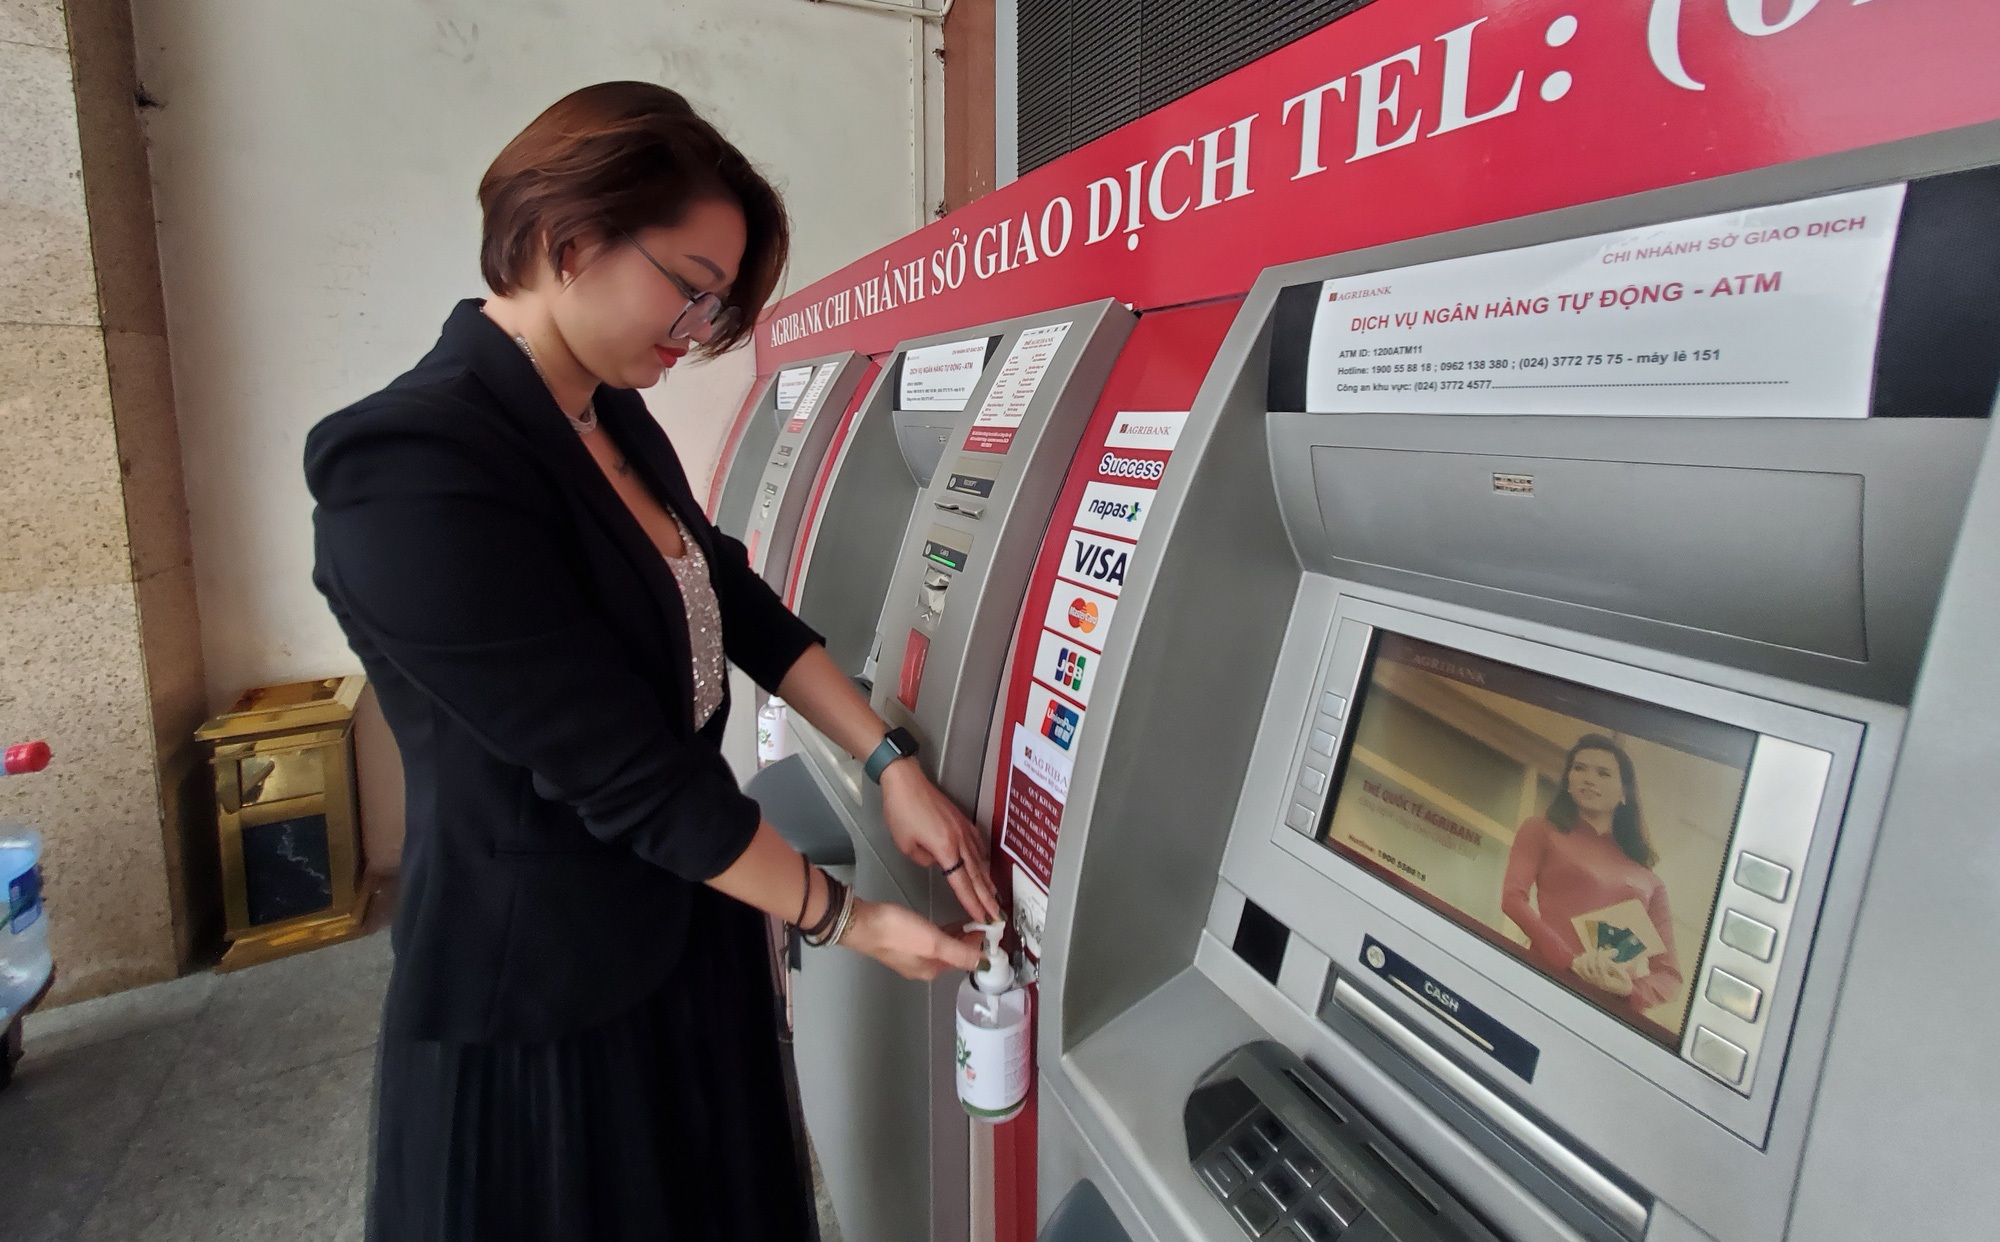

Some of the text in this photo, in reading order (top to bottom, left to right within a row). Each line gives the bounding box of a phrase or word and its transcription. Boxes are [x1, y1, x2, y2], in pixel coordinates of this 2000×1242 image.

[770, 301, 823, 347] AGRIBANK
[825, 289, 851, 329] CHI
[853, 257, 925, 320] NHÁNH
[932, 228, 968, 296] SỞ
[974, 196, 1073, 279] GIAO
[1084, 113, 1259, 251] DỊCH
[1282, 15, 1578, 182] TEL:
[1602, 216, 1866, 265] CHI NHÁNH SỞ GIAO DỊCH
[1337, 286, 1392, 301] AGRIBANK
[1351, 315, 1389, 334] DỊCH
[1395, 311, 1417, 329] VỤ
[1423, 303, 1479, 324] NGÂN
[1485, 296, 1549, 318] HÀNG
[1558, 291, 1593, 314] TỰ
[1600, 282, 1683, 310] ĐỘNG
[1710, 271, 1782, 298] ATM
[1338, 365, 1369, 375] Hotline:
[1371, 365, 1391, 374] 1900
[1394, 364, 1405, 373] 55
[1406, 363, 1418, 372] 88
[1421, 363, 1432, 372] 18
[1440, 361, 1464, 371] 0962
[1467, 361, 1486, 370] 138
[1489, 360, 1508, 369] 380
[1519, 357, 1548, 370] (024)
[1552, 355, 1582, 367] 3772
[1586, 354, 1602, 365] 75
[1607, 353, 1623, 365] 75
[1636, 351, 1669, 366] máy
[1693, 349, 1721, 361] 151
[1339, 346, 1422, 358] ATM ID: 1200ATM11
[1337, 383, 1358, 393] Công
[1373, 383, 1389, 391] khu
[1414, 381, 1437, 392] (024)
[1440, 380, 1464, 390] 3772
[1126, 425, 1172, 435] AGRIBANK
[1100, 454, 1162, 478] Success
[1088, 499, 1128, 520] napas
[1075, 539, 1128, 586] VISA
[1069, 606, 1098, 625] MasterCard
[1057, 658, 1083, 681] JCB
[1046, 707, 1076, 736] UnionPay
[1424, 810, 1482, 846] AGRIBANK
[1424, 980, 1460, 1012] CASH
